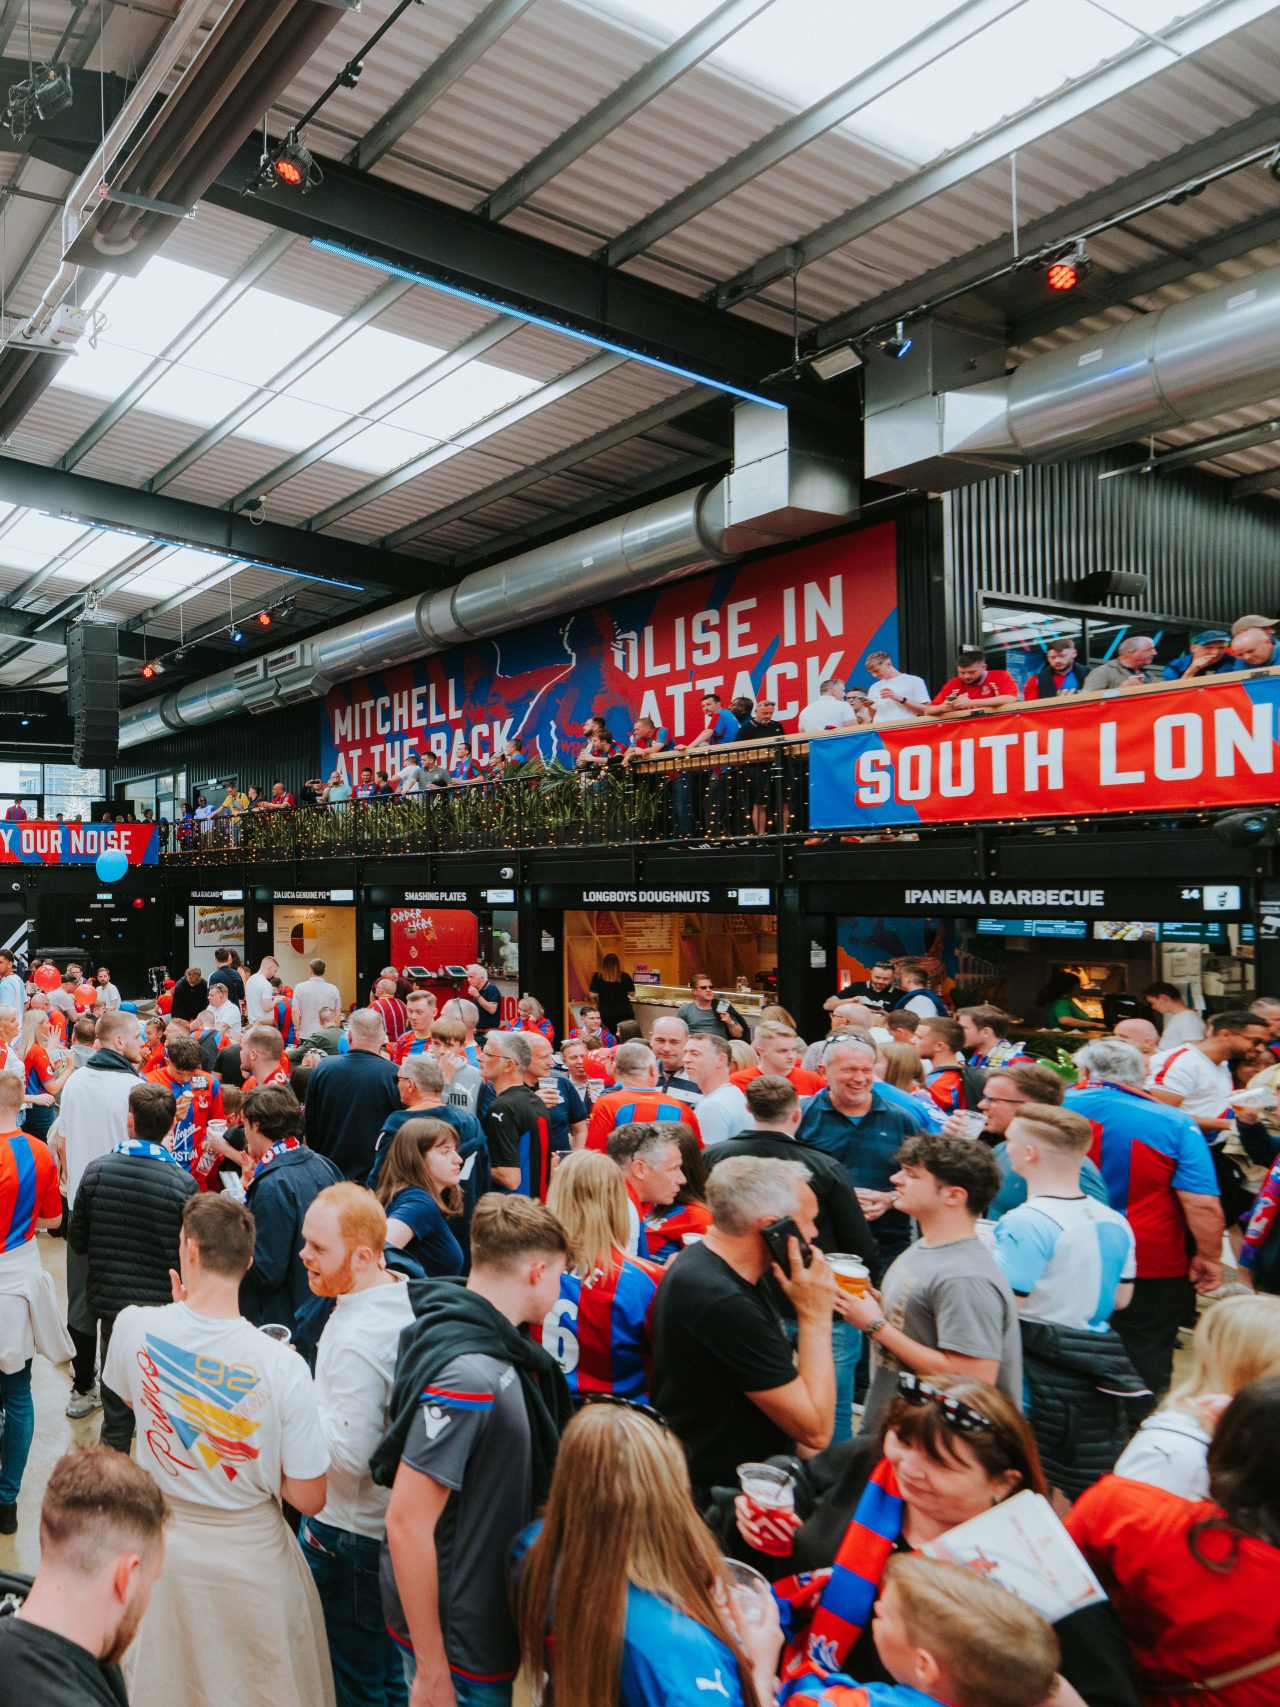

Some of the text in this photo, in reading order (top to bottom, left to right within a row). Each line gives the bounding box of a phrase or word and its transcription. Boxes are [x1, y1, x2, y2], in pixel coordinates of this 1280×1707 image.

[783, 575, 844, 647] IN
[334, 677, 463, 745] MITCHELL
[859, 703, 1274, 804] SOUTH LON
[337, 748, 363, 787] AT
[21, 829, 62, 854] OUR
[70, 830, 132, 856] NOISE
[404, 891, 467, 902] SMASHING PLATES
[583, 890, 711, 903] LONGBOYS DOUGHNUTS
[727, 890, 737, 898] 13
[905, 889, 1105, 907] IPANEMA BARBECUE
[1181, 889, 1200, 899] 14
[390, 908, 422, 923] ORDER
[173, 1121, 201, 1151] Virgin
[195, 1354, 257, 1395] 92
